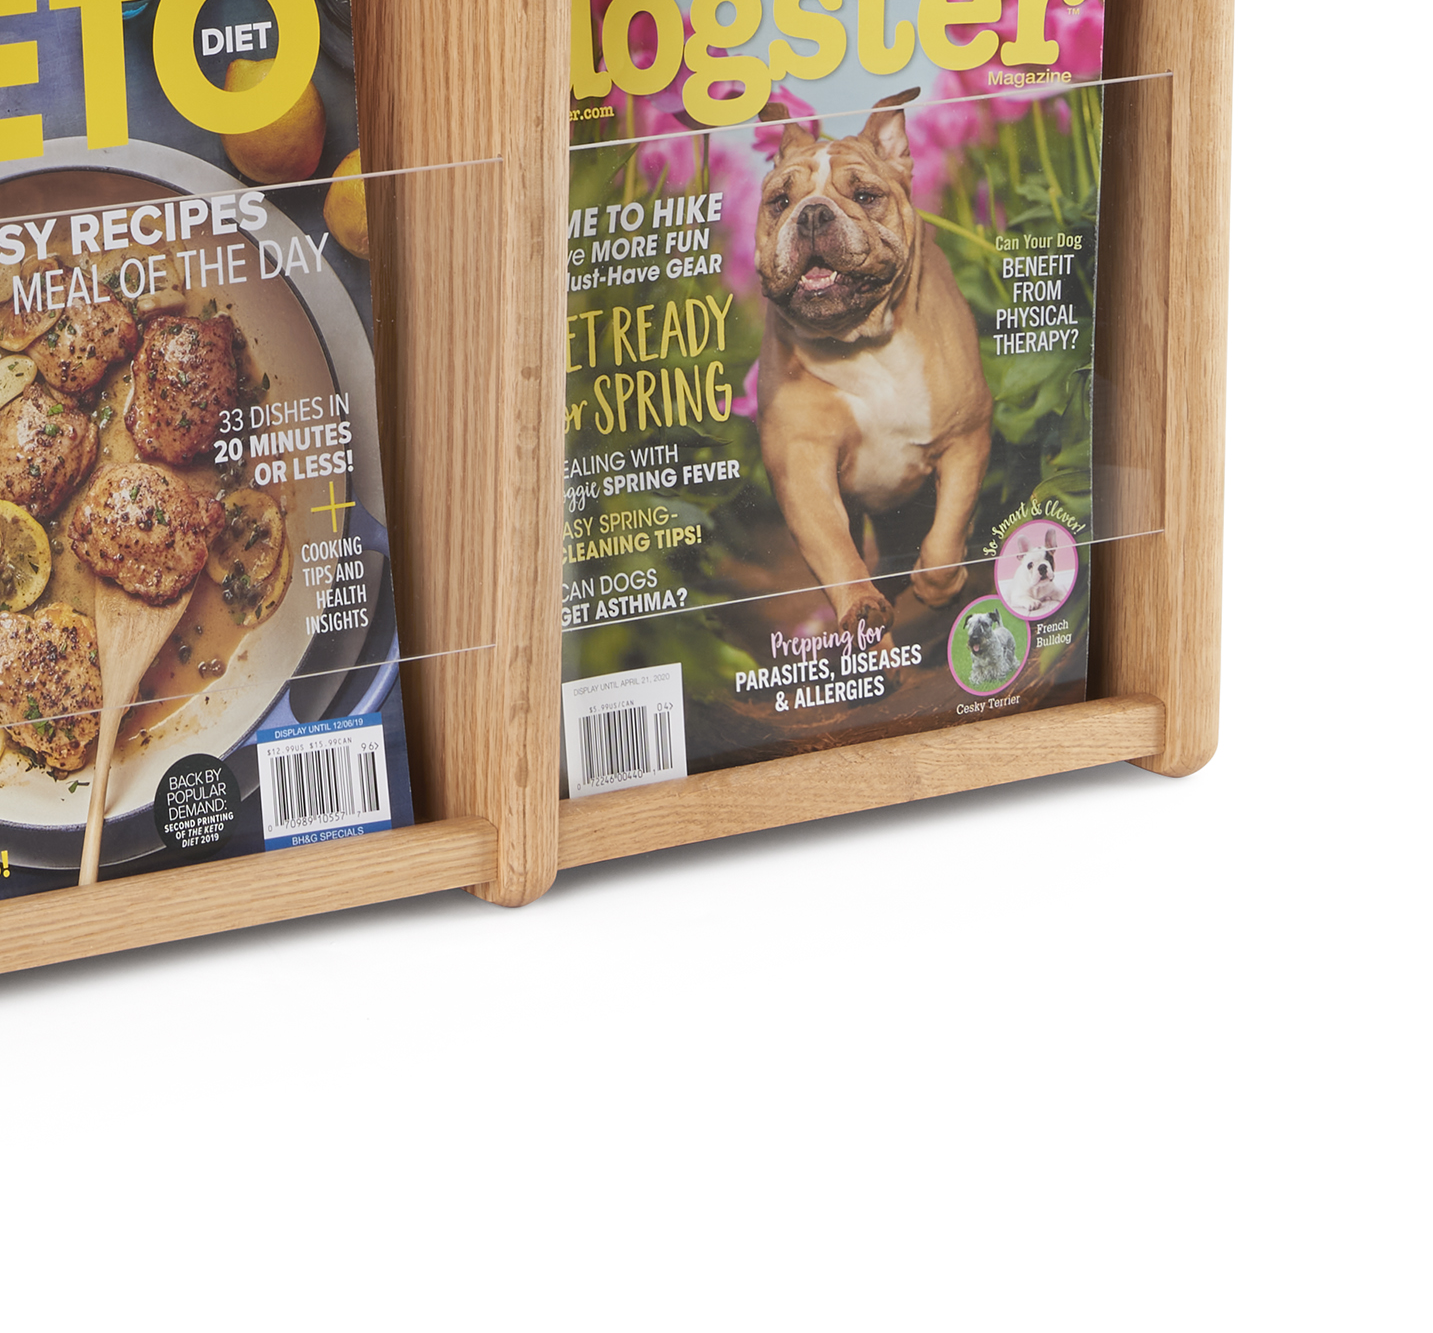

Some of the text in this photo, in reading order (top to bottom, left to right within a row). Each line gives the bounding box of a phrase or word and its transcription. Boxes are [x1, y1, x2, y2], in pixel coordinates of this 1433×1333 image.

[201, 21, 272, 57] DIET
[988, 68, 1072, 87] Magazine
[70, 191, 268, 254] RECIPES
[606, 193, 723, 233] TO HIKE
[996, 233, 1082, 251] Can Your Dog
[12, 265, 111, 315] MEAL
[119, 254, 167, 300] OF
[178, 246, 247, 289] THE
[258, 233, 329, 280] DAY
[1003, 254, 1074, 278] BENEFIT
[613, 293, 733, 366] READY
[996, 304, 1078, 329] PHYSICAL
[993, 329, 1079, 355] THERAPY?
[593, 361, 732, 434] SPRING
[683, 460, 740, 485] FEVER
[301, 536, 362, 563] COOKING
[595, 588, 688, 620] ASTHMA?
[306, 608, 368, 635] INSIGHTS
[1036, 620, 1069, 635] French
[1036, 632, 1072, 648] Bulldog
[736, 644, 922, 693] PARASITES, DISEASES
[794, 675, 885, 709] ALLERGIES
[956, 694, 1020, 716] Cesky Terrier
[333, 718, 363, 731] 12/06/19
[166, 783, 226, 805] POPULAR
[164, 812, 234, 833] SECOND PRINTING
